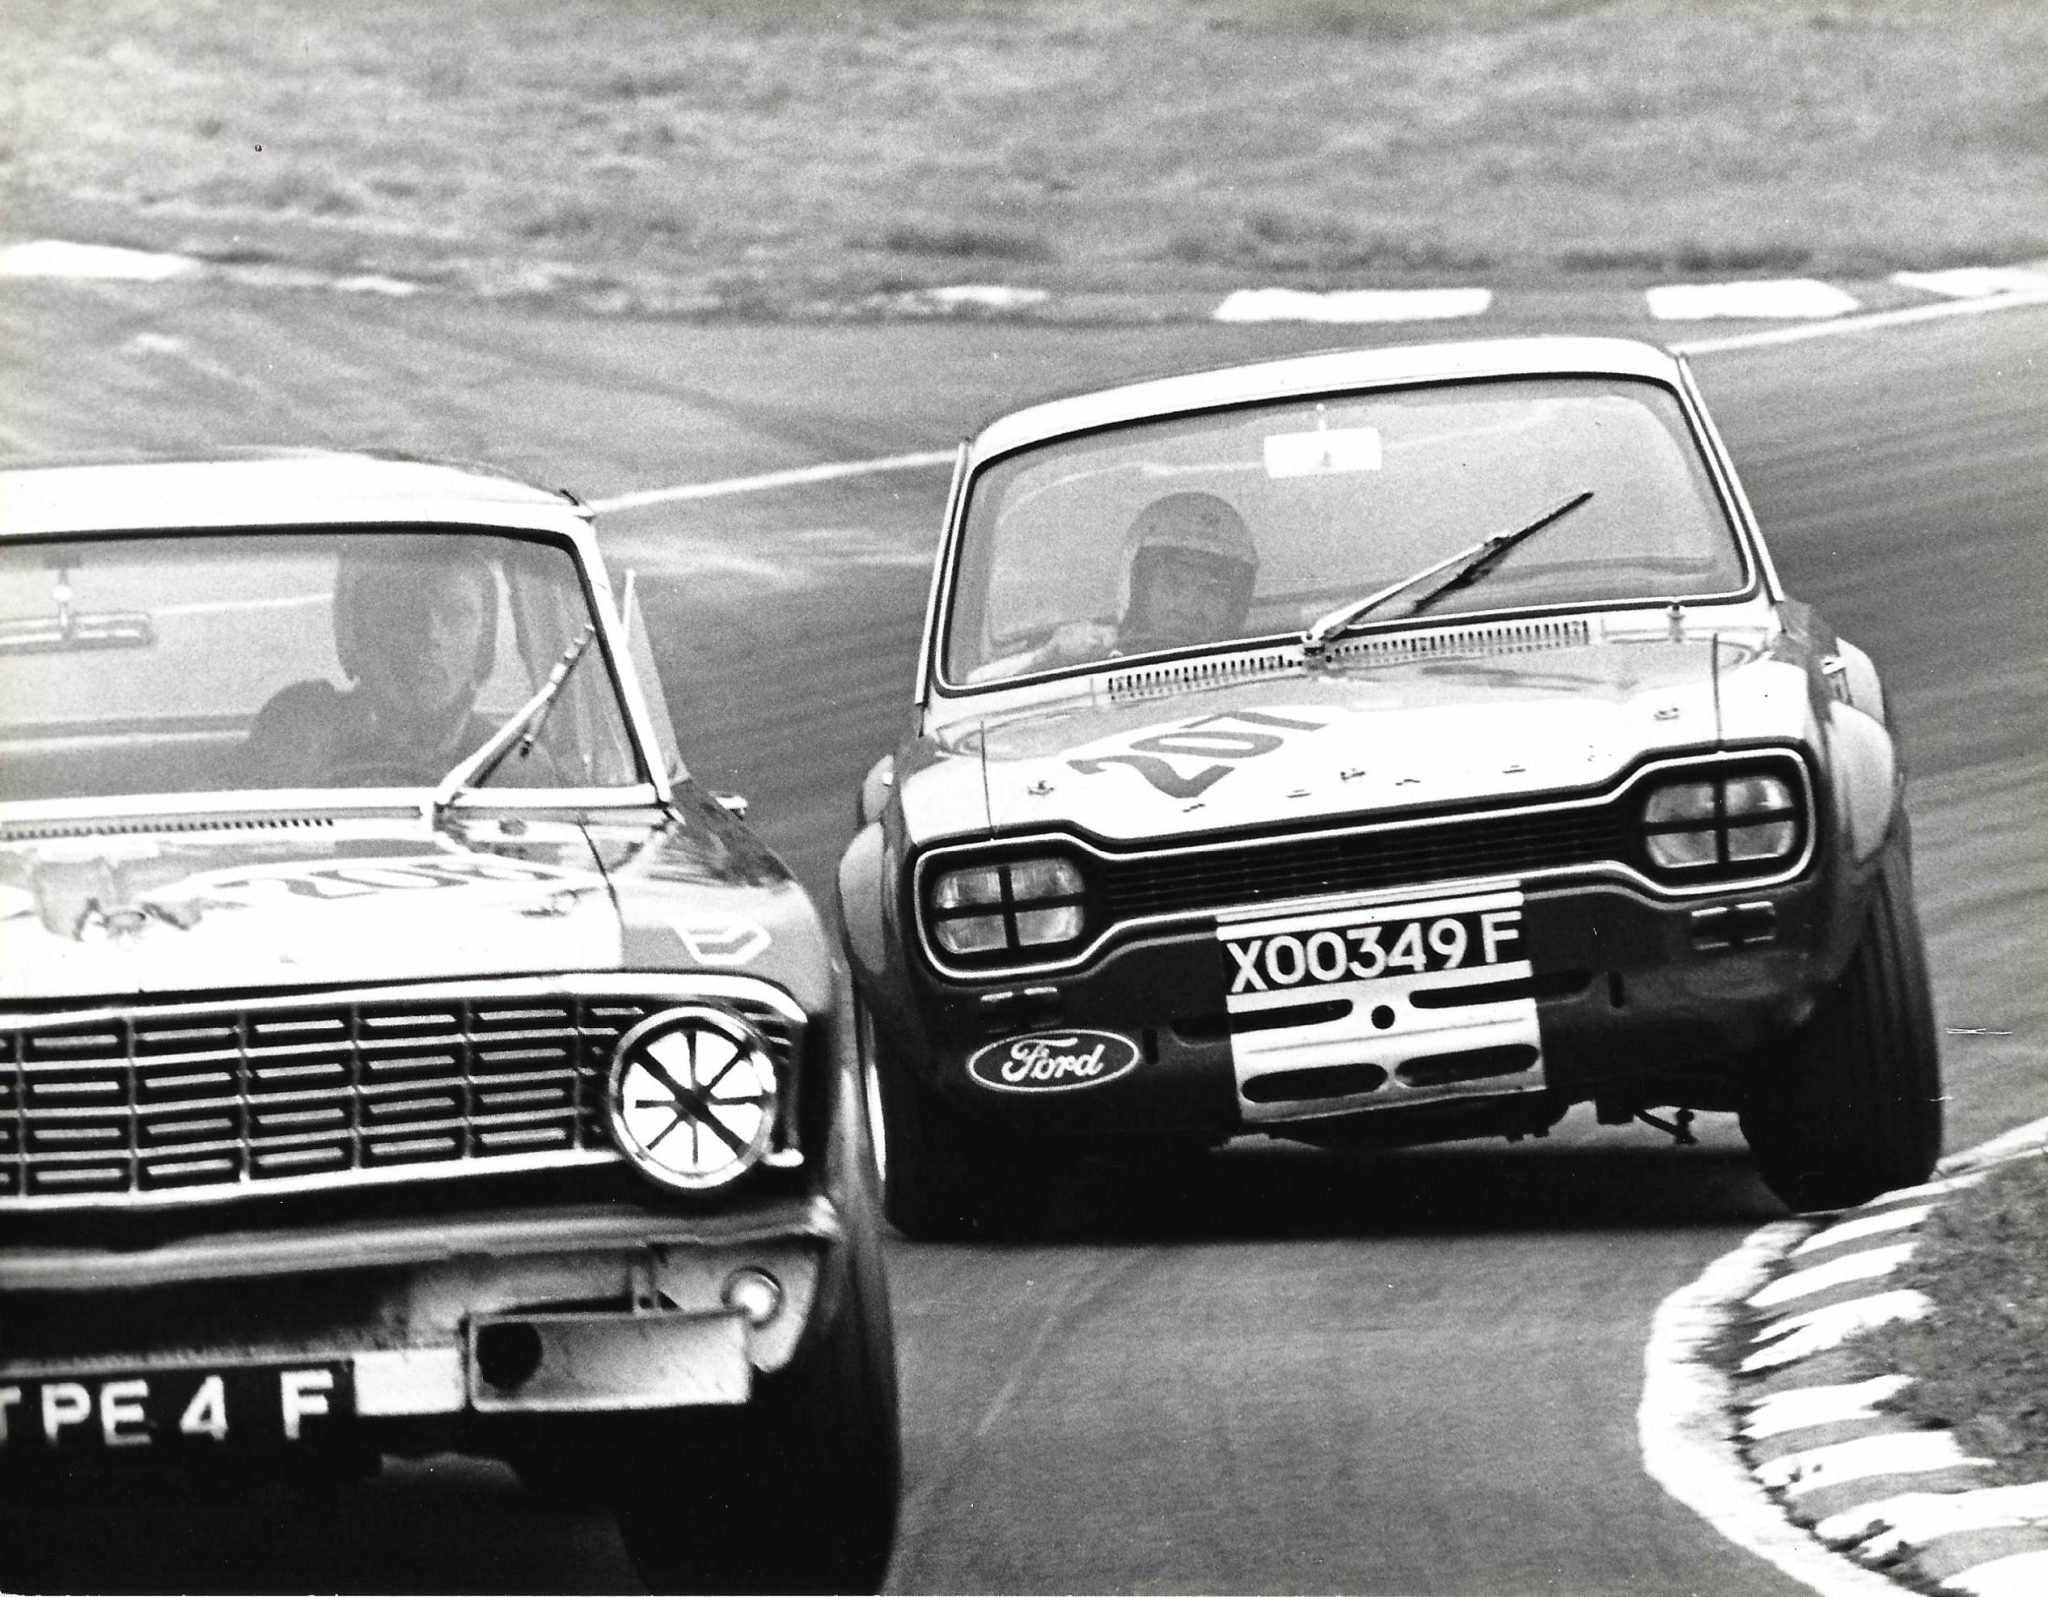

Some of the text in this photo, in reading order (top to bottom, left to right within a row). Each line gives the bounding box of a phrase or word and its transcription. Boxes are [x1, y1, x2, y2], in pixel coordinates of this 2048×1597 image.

[1067, 711, 1329, 798] 201
[1001, 1037, 1106, 1083] Ford
[279, 1369, 334, 1440] F
